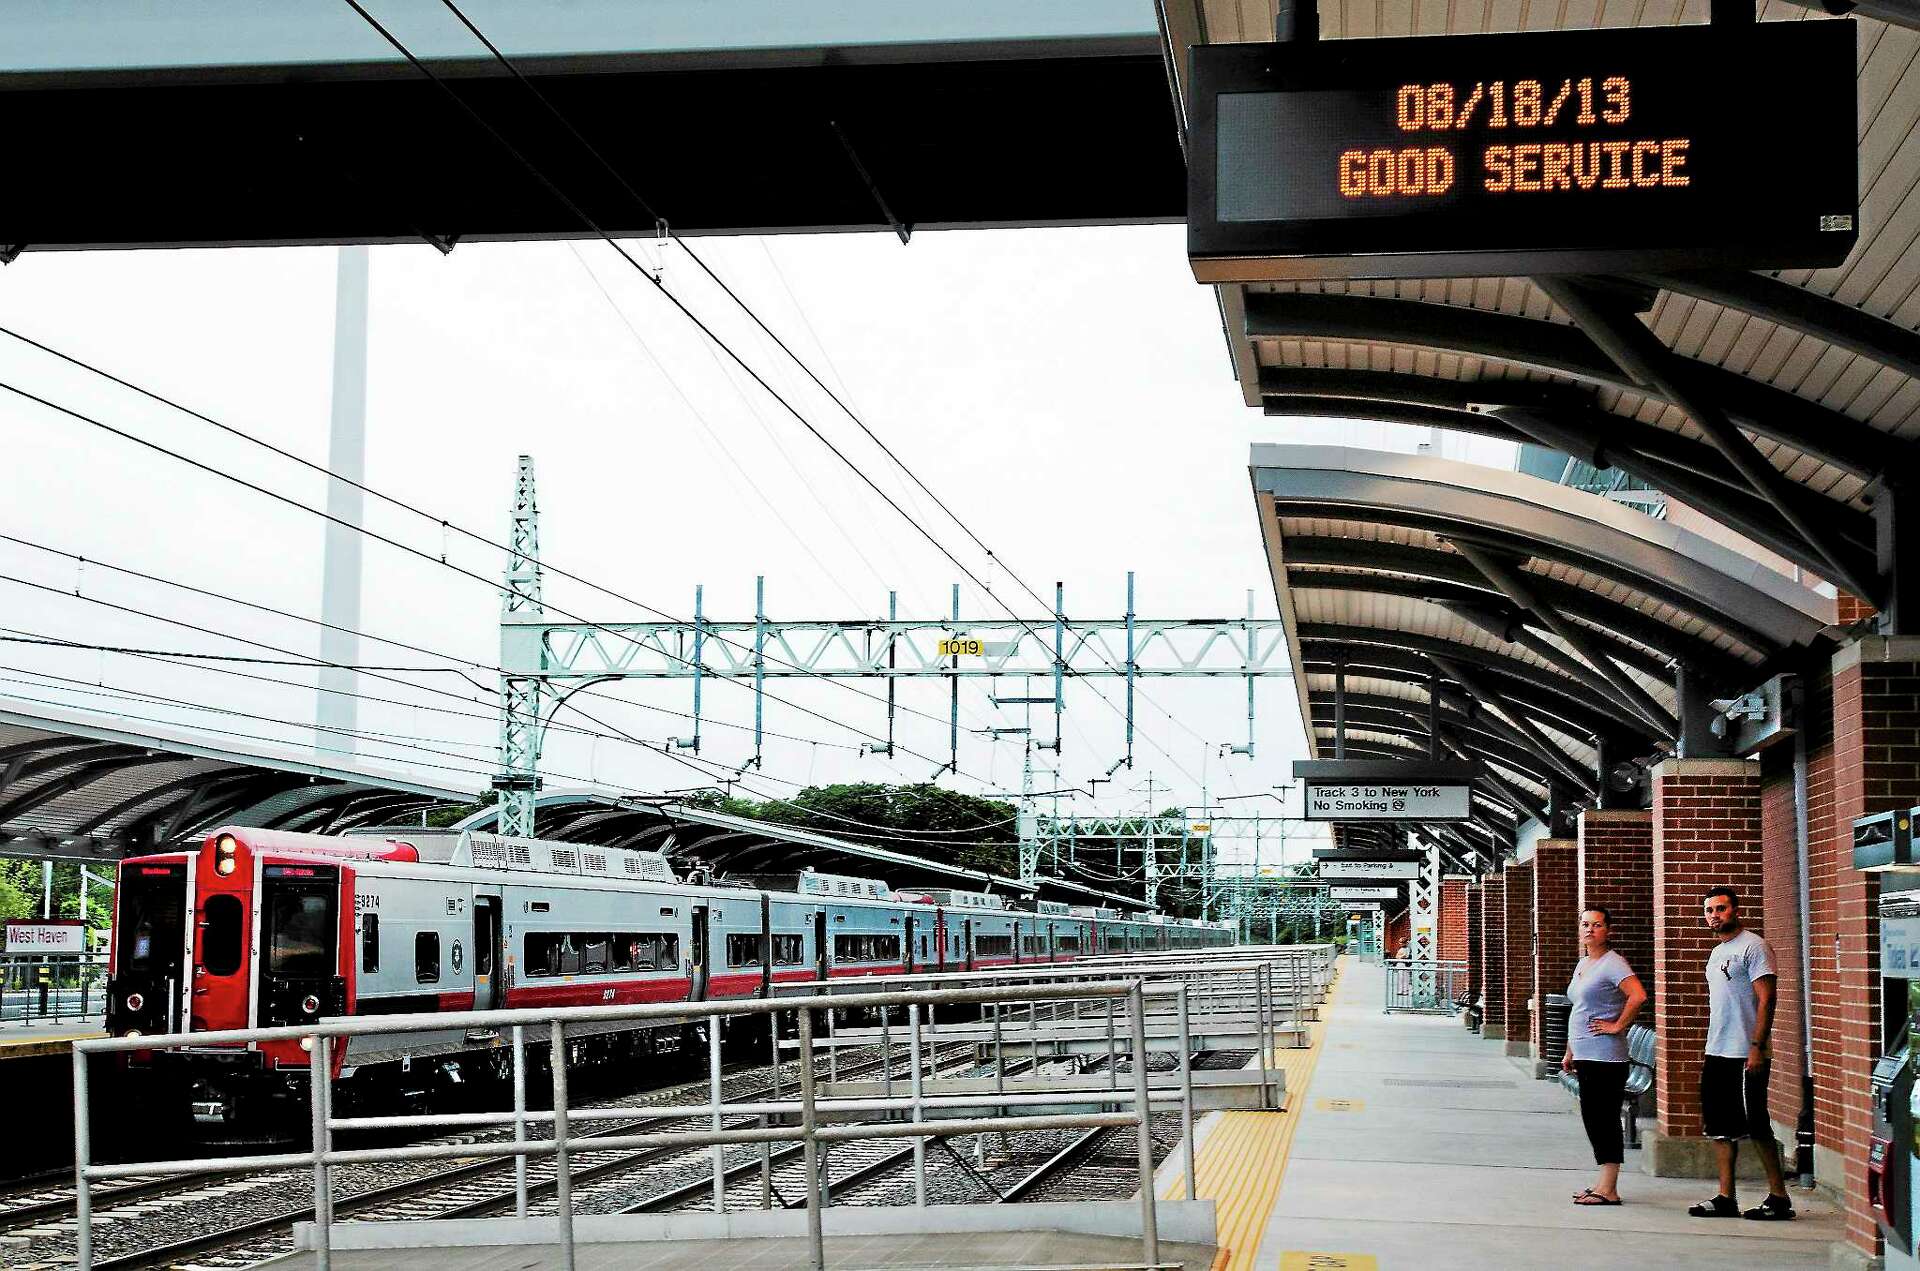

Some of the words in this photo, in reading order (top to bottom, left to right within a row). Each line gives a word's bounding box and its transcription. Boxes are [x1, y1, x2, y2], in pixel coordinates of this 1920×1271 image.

[1396, 75, 1632, 131] 08/18/13
[1339, 147, 1455, 197] GOOD
[1483, 138, 1691, 193] SERVICE
[943, 641, 979, 655] 1019
[1313, 787, 1346, 797] Track
[1351, 787, 1360, 797] 3
[1364, 787, 1377, 797] to
[1382, 787, 1408, 797] New
[1413, 787, 1441, 797] York
[1313, 800, 1330, 810] No
[1335, 800, 1388, 812] Smoking
[361, 894, 380, 909] 9274
[9, 927, 35, 943] West
[38, 927, 68, 943] Haven
